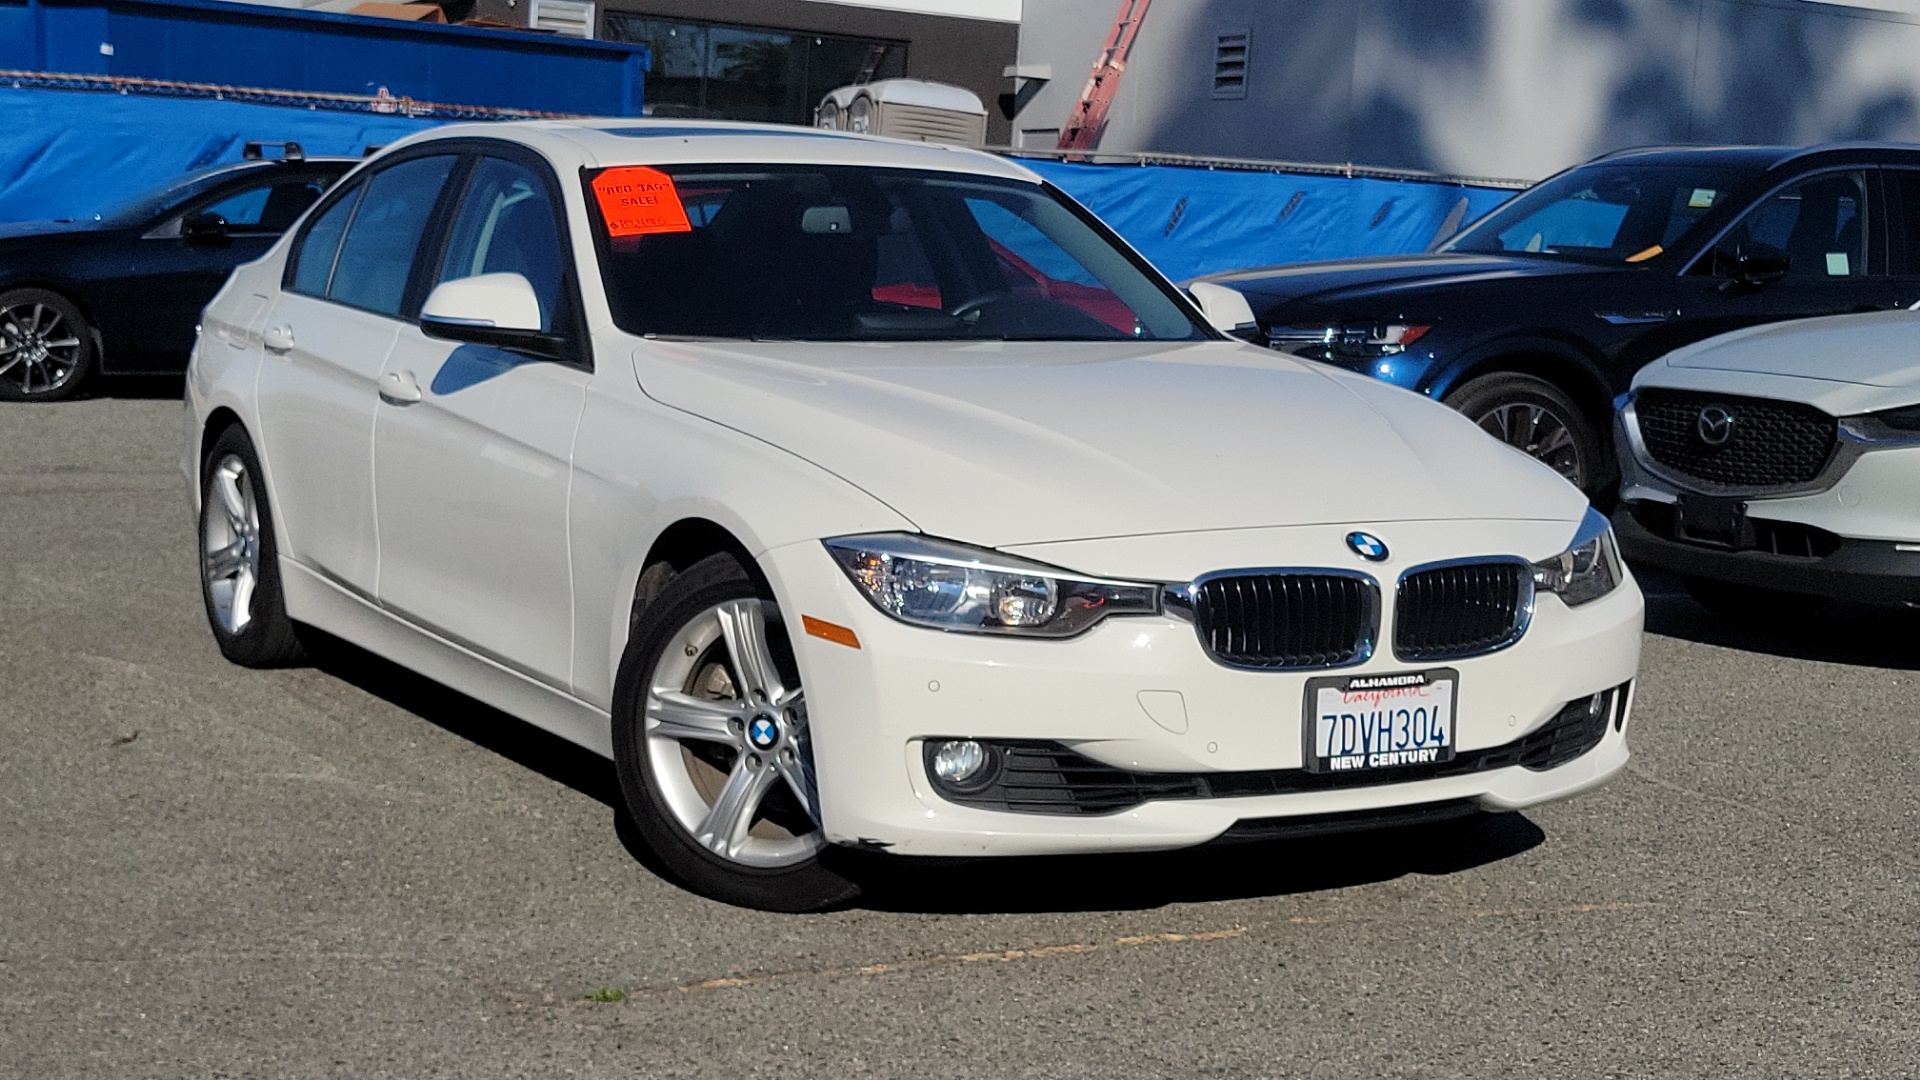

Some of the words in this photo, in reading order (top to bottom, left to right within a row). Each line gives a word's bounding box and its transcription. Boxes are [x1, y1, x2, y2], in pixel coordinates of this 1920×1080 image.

[1350, 675, 1424, 688] ALHAMBRA
[1322, 706, 1444, 756] 7DVH304
[1330, 756, 1365, 771] NEW
[1369, 749, 1438, 767] CENTURY
